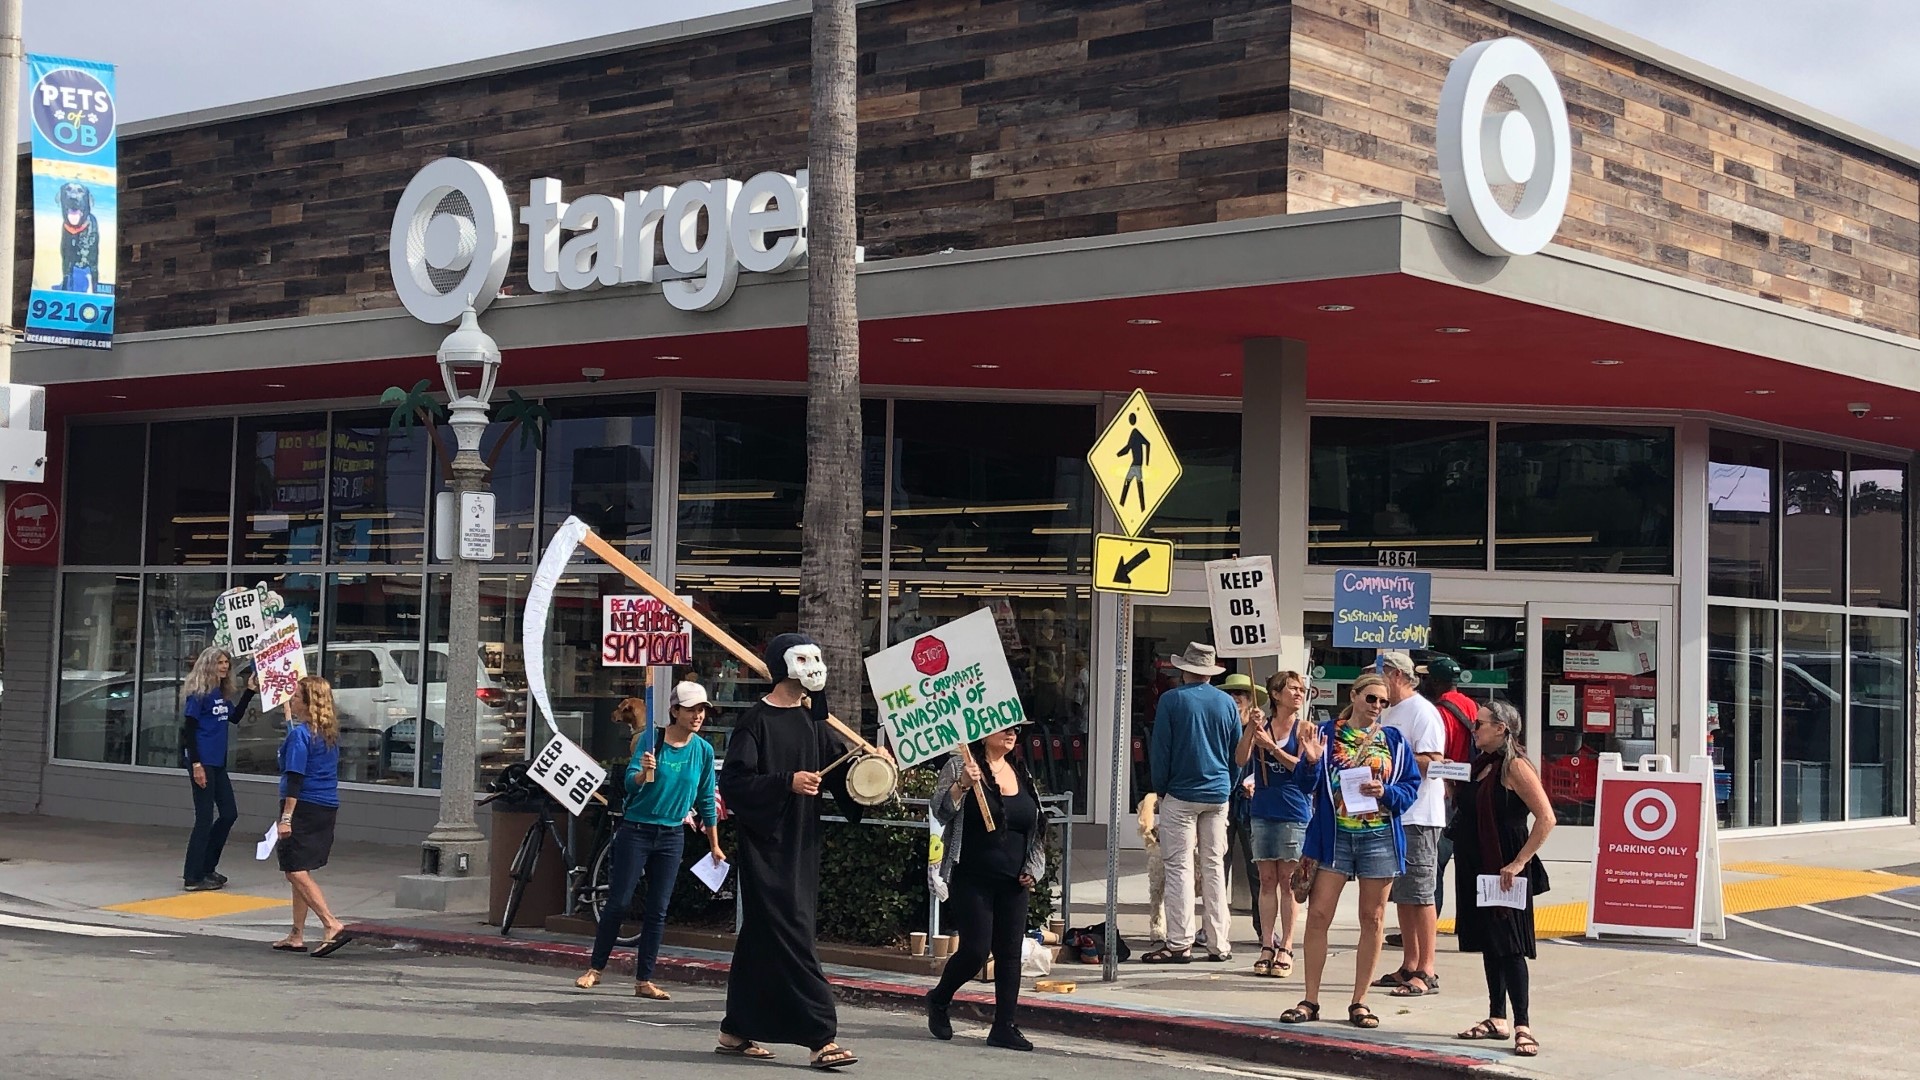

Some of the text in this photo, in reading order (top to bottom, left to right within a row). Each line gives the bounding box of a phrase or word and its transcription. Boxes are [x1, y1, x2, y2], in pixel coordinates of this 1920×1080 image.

[40, 84, 109, 113] PETS
[67, 110, 86, 129] of
[54, 122, 98, 147] OB
[519, 168, 809, 312] targe
[32, 299, 113, 325] 92107
[27, 334, 112, 349] OCEANBEACHSANDIEGO.COM
[1379, 551, 1415, 567] 4864
[1220, 570, 1263, 590] KEEP
[229, 594, 254, 611] KEEP
[611, 598, 626, 612] BE
[627, 599, 635, 611] A
[1230, 598, 1260, 618] OB,
[236, 615, 255, 630] OB,
[1230, 624, 1266, 645] OB!
[604, 632, 692, 666] SHOP LOCAL
[916, 645, 943, 666] STOP
[881, 685, 915, 710] THE
[888, 681, 986, 738] INVASION OF
[898, 697, 1022, 763] OCEAN BEACH
[533, 741, 562, 778] KEEP
[554, 763, 580, 787] OB,
[569, 771, 599, 805] OB!
[1609, 844, 1687, 856] PARKING ONLY
